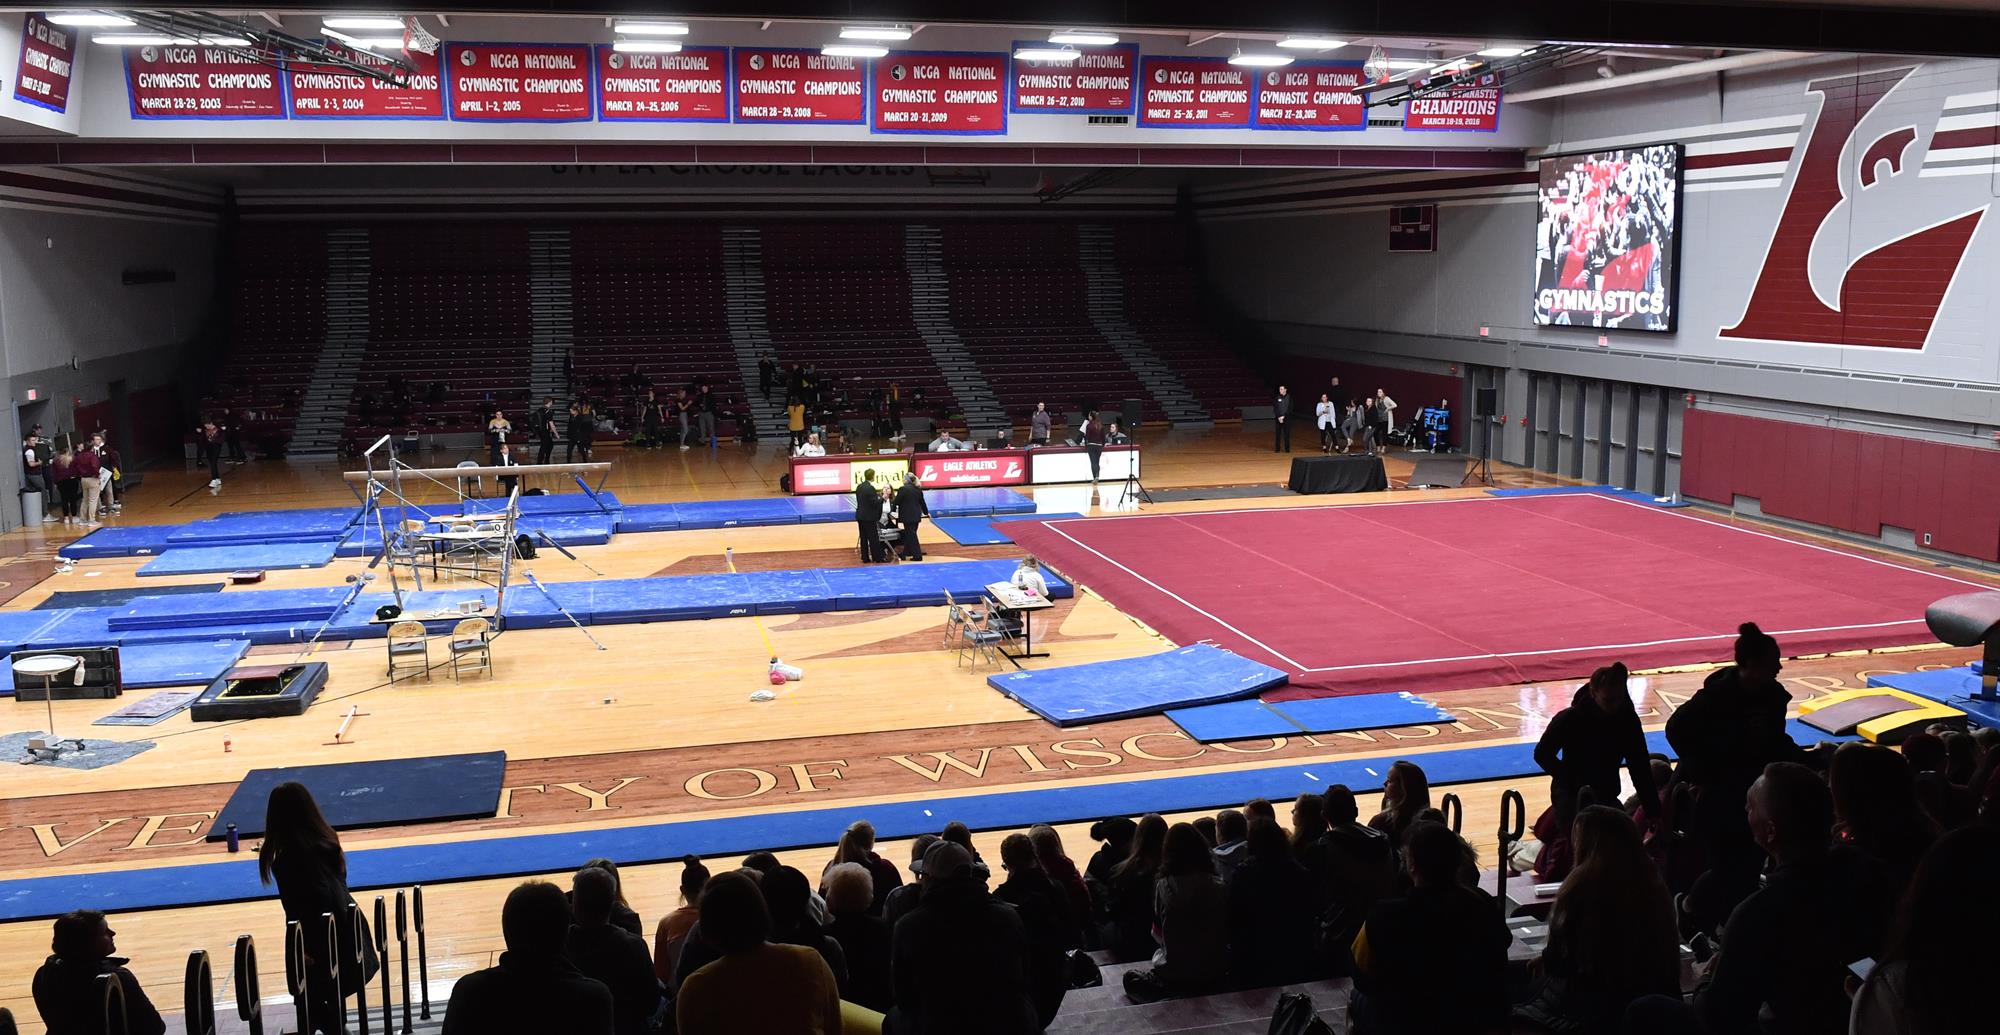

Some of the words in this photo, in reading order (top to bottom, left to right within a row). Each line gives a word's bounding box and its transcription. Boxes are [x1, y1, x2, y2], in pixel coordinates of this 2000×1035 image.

[165, 48, 197, 63] NCGA
[490, 54, 519, 69] NCGA
[525, 55, 576, 70] NATIONAL
[630, 55, 657, 69] NCGA
[661, 55, 709, 70] NATIONAL
[772, 54, 800, 69] NCGA
[807, 55, 855, 70] NATIONAL
[1079, 55, 1125, 69] NATIONAL
[913, 66, 940, 79] NCGA
[948, 66, 996, 80] NATIONAL
[1170, 71, 1194, 84] NCGA
[1201, 71, 1243, 85] NATIONAL
[1285, 73, 1309, 86] NCGA
[1317, 73, 1358, 86] NATIONAL
[138, 73, 200, 89] GYMNASTIC
[208, 73, 272, 89] CHAMPIONS
[459, 77, 520, 93] GYMNASTIC
[524, 78, 584, 93] CHAMPIONS
[604, 77, 660, 92] GYMNASTIC
[665, 79, 722, 93] CHAMPIONS
[740, 80, 797, 94] GYMNASTIC
[804, 81, 861, 95] CHAMPIONS
[1019, 74, 1072, 89] GYMNASTIC
[1076, 76, 1130, 90] CHAMPIONS
[882, 89, 936, 103] GYMNASTIC
[944, 90, 998, 104] CHAMPIONS
[1020, 95, 1044, 105] MARCH
[1070, 97, 1085, 107] 2010
[1148, 89, 1194, 103] GYMNASTIC
[1200, 90, 1247, 103] CHAMPIONS
[1260, 90, 1308, 104] GYMNASTIC
[1313, 91, 1362, 105] CHAMPIONS
[142, 98, 171, 109] MARCH
[200, 98, 221, 109] 2003
[296, 98, 320, 109] APRIL
[343, 99, 364, 110] 2004
[461, 101, 483, 112] APRIL
[503, 101, 521, 112] 2005
[606, 100, 633, 111] MARCH
[661, 101, 679, 112] 2006
[1410, 99, 1497, 115] CHAMPIONS
[742, 106, 768, 117] MARCH
[794, 107, 811, 117] 2008
[884, 112, 909, 122] MARCH
[1148, 109, 1171, 119] MARCH
[1196, 110, 1208, 119] 2011
[1260, 108, 1283, 118] MARCH
[1540, 288, 1664, 315] GYMNASTICS
[943, 462, 963, 472] EAGLE
[965, 460, 997, 471] ATHLETICS
[683, 759, 849, 801] OF
